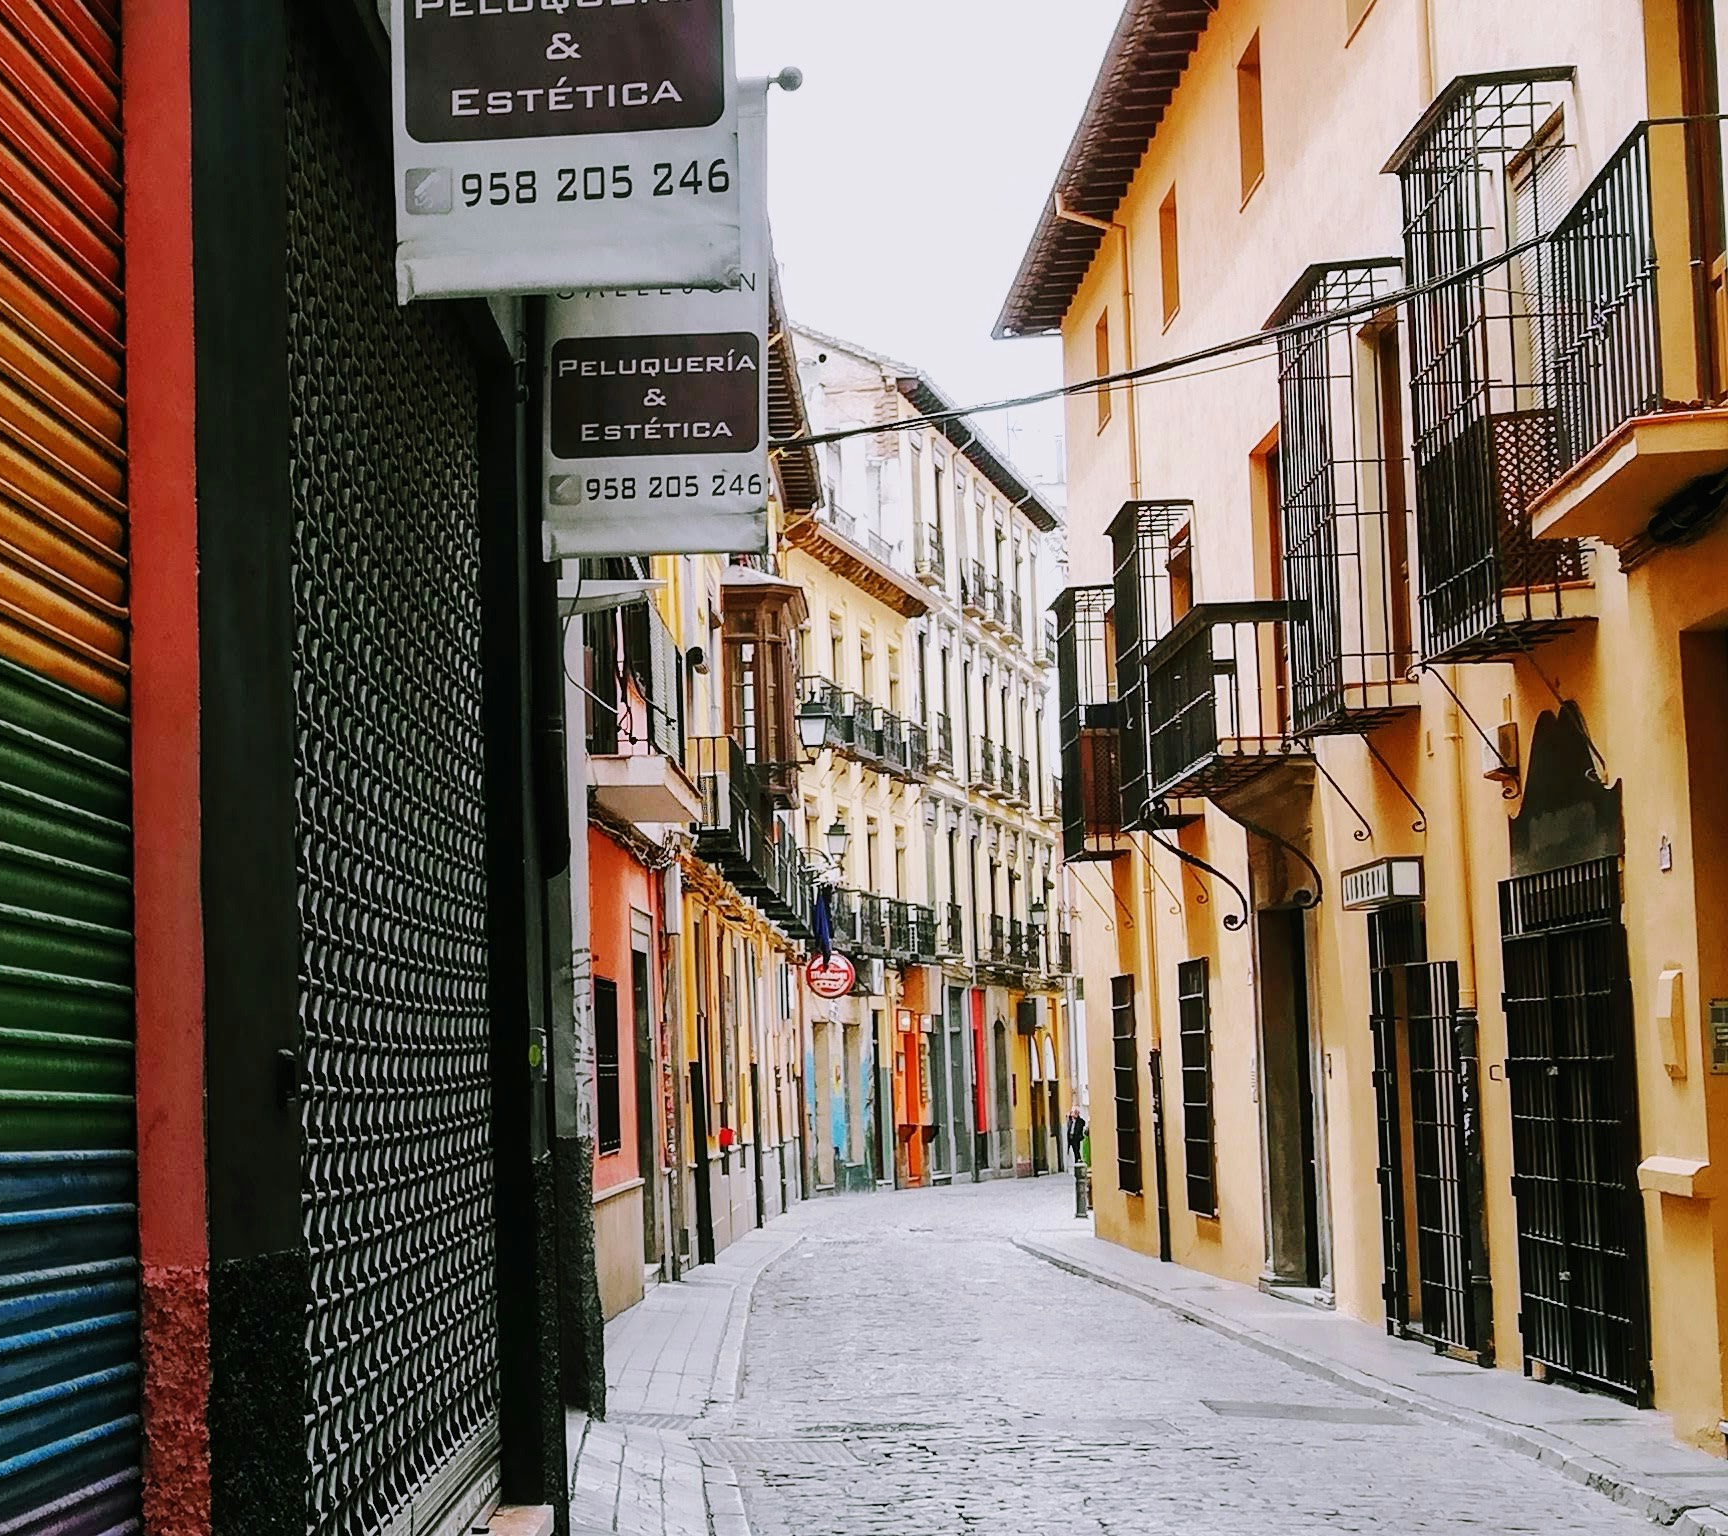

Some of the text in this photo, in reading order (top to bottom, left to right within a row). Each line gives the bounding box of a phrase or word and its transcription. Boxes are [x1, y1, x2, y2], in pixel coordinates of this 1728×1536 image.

[545, 32, 582, 61] &
[450, 76, 683, 117] ESTÉTICA
[461, 158, 730, 207] 958 205 246
[558, 348, 757, 378] PELUQUERÍA
[642, 388, 667, 407] &
[580, 416, 733, 442] ESTÉTICA
[585, 473, 762, 501] 958 205 246
